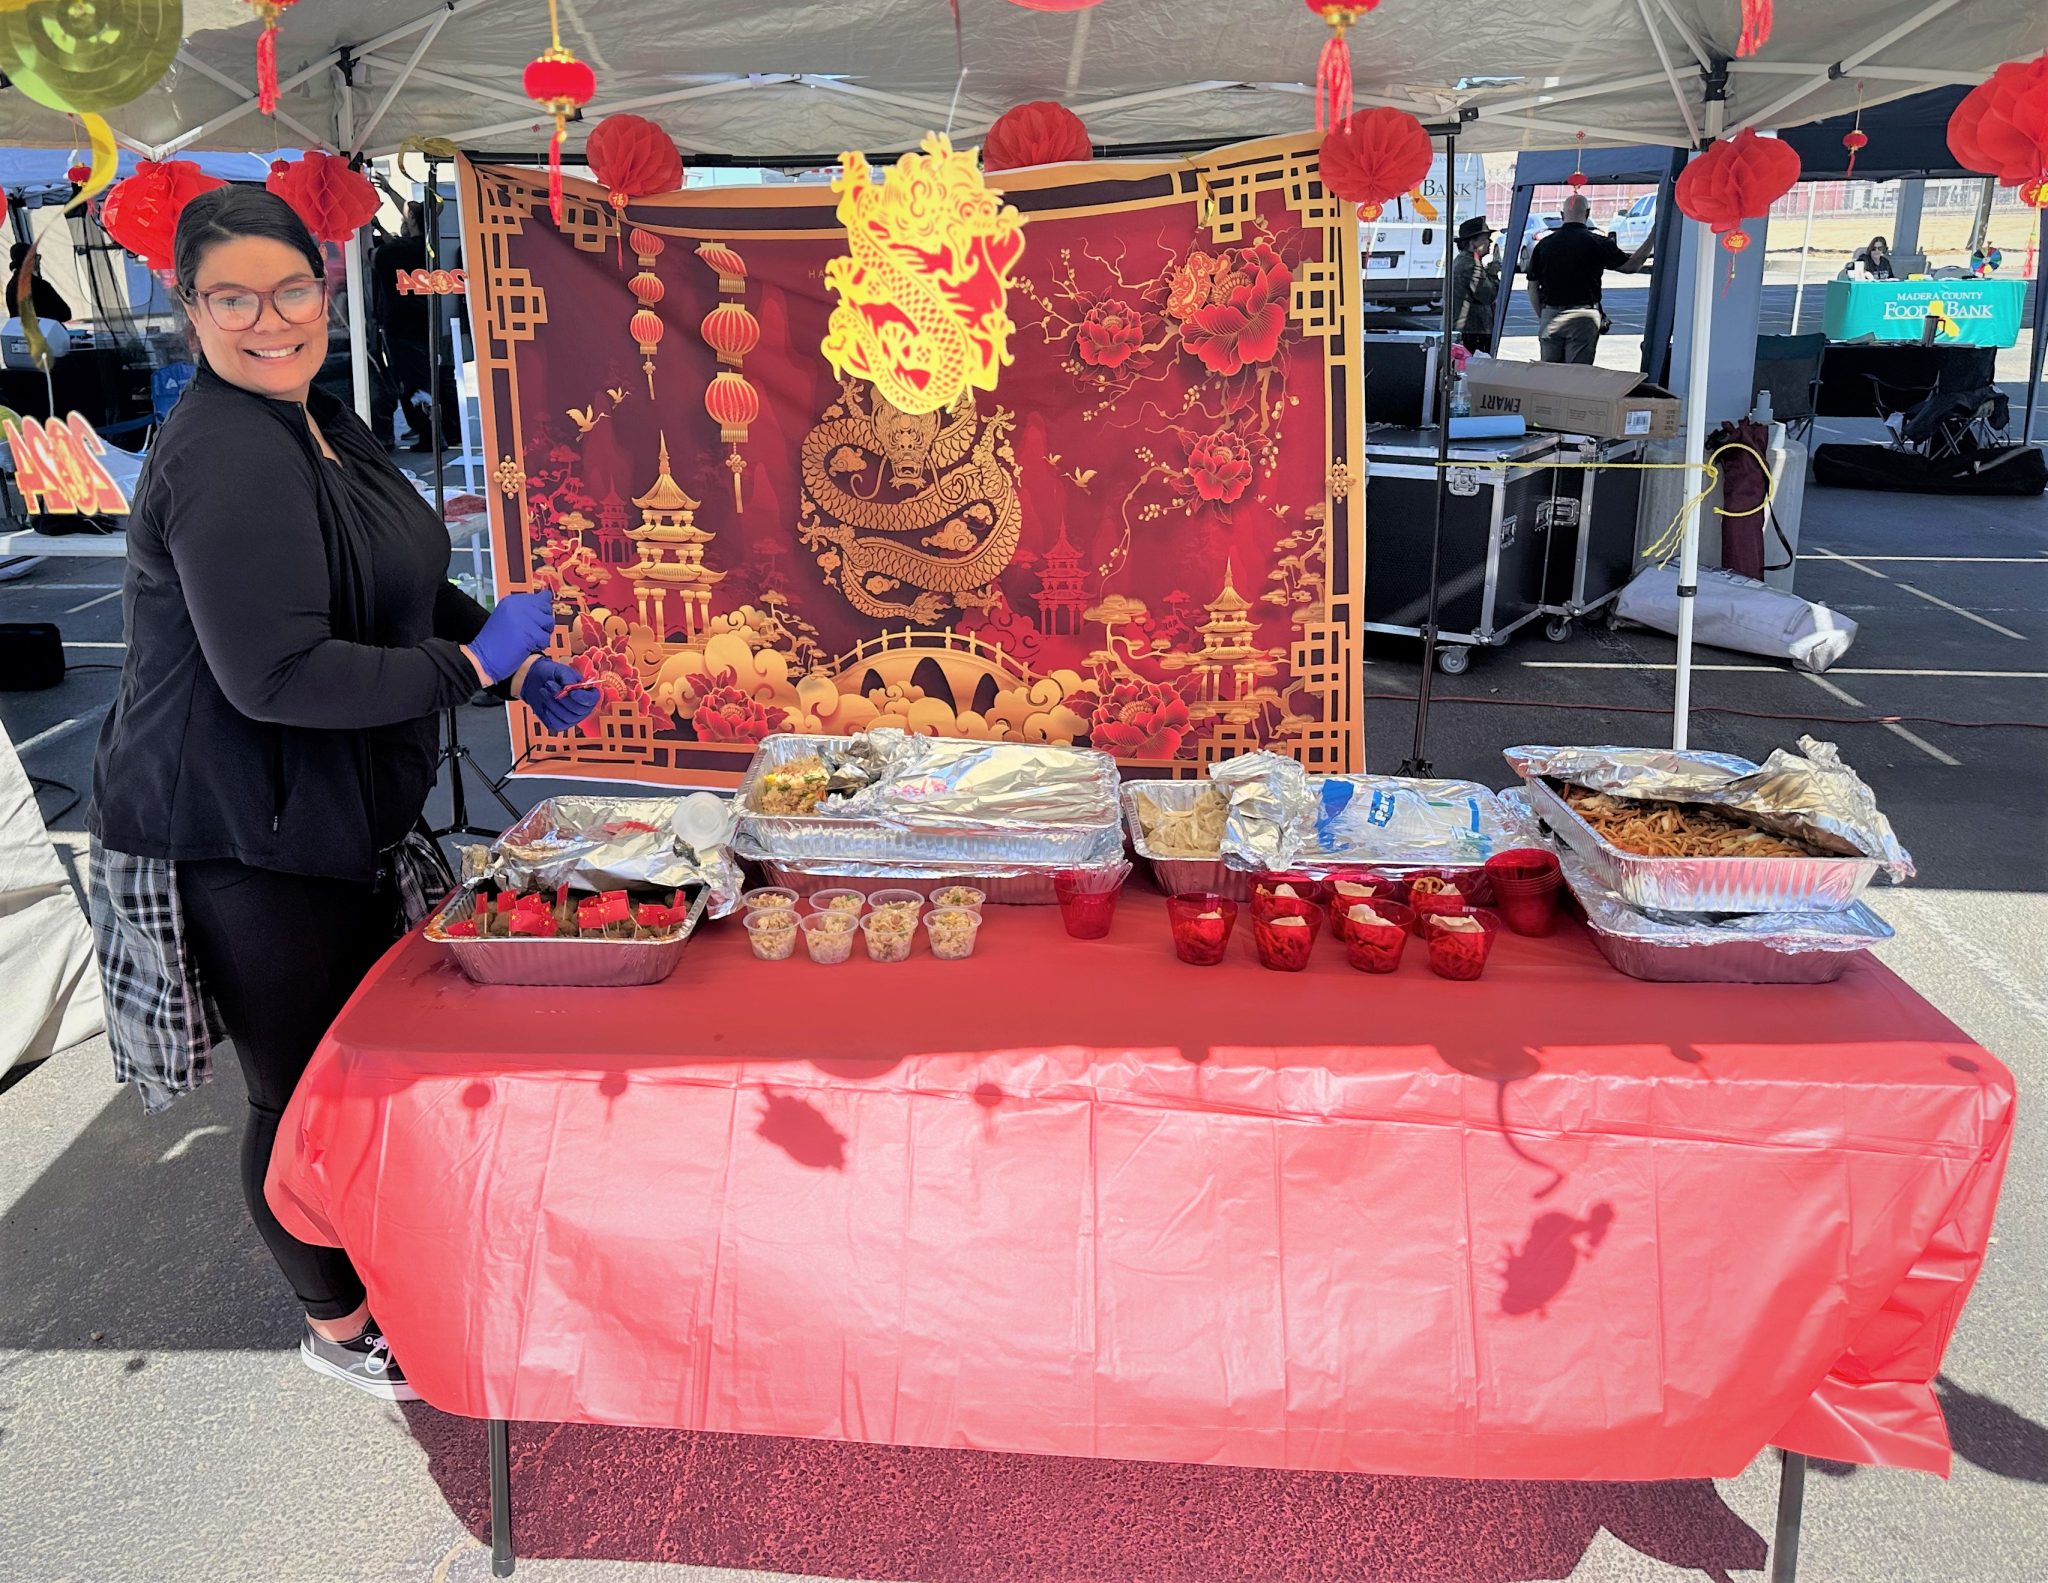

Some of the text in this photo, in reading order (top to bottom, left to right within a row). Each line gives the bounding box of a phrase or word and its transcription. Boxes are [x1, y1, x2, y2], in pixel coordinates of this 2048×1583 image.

[1897, 291, 1983, 301] MADERA COUNTY
[1884, 301, 1993, 317] FOOD BANK
[1480, 394, 1521, 413] EMART
